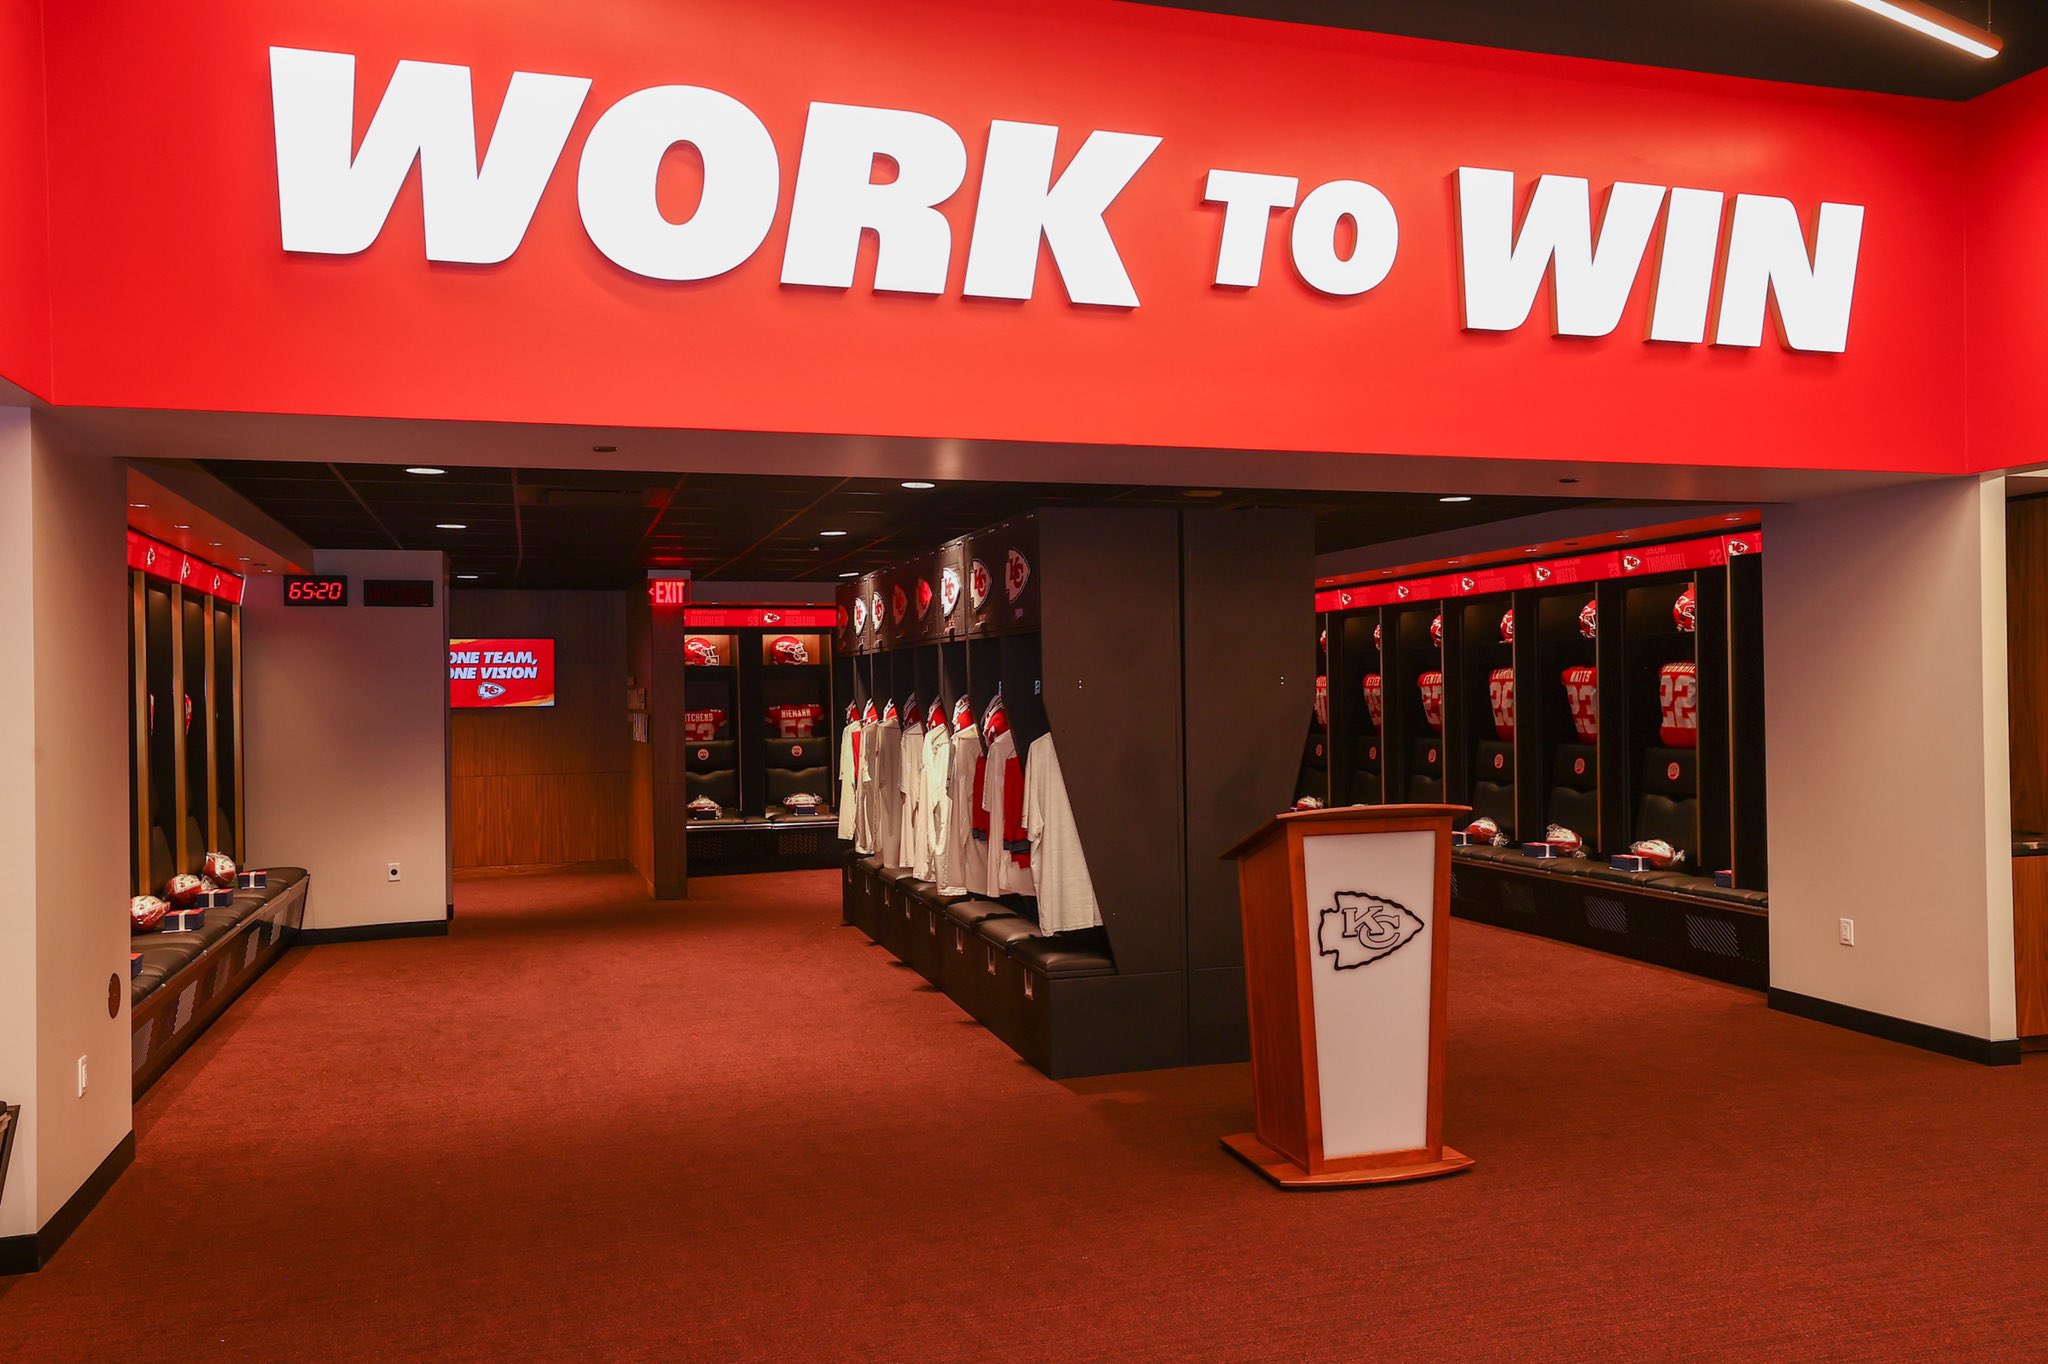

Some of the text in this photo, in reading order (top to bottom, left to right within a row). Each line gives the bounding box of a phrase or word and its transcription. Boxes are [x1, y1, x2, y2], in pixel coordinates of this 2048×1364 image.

[269, 46, 1866, 354] WORK TO WIN
[1709, 549, 1724, 566] 22
[1608, 562, 1620, 577] 23
[288, 582, 342, 600] 65:20
[655, 581, 685, 604] EXIT
[747, 616, 759, 627] 53
[484, 651, 538, 665] TEAM,
[480, 667, 538, 679] VISION
[1570, 670, 1592, 683] WATTS
[1566, 685, 1597, 734] 23
[1660, 675, 1697, 728] 22
[684, 713, 714, 722] ITCHENS
[781, 708, 811, 718] NIEMANN
[1342, 906, 1400, 950] KC
